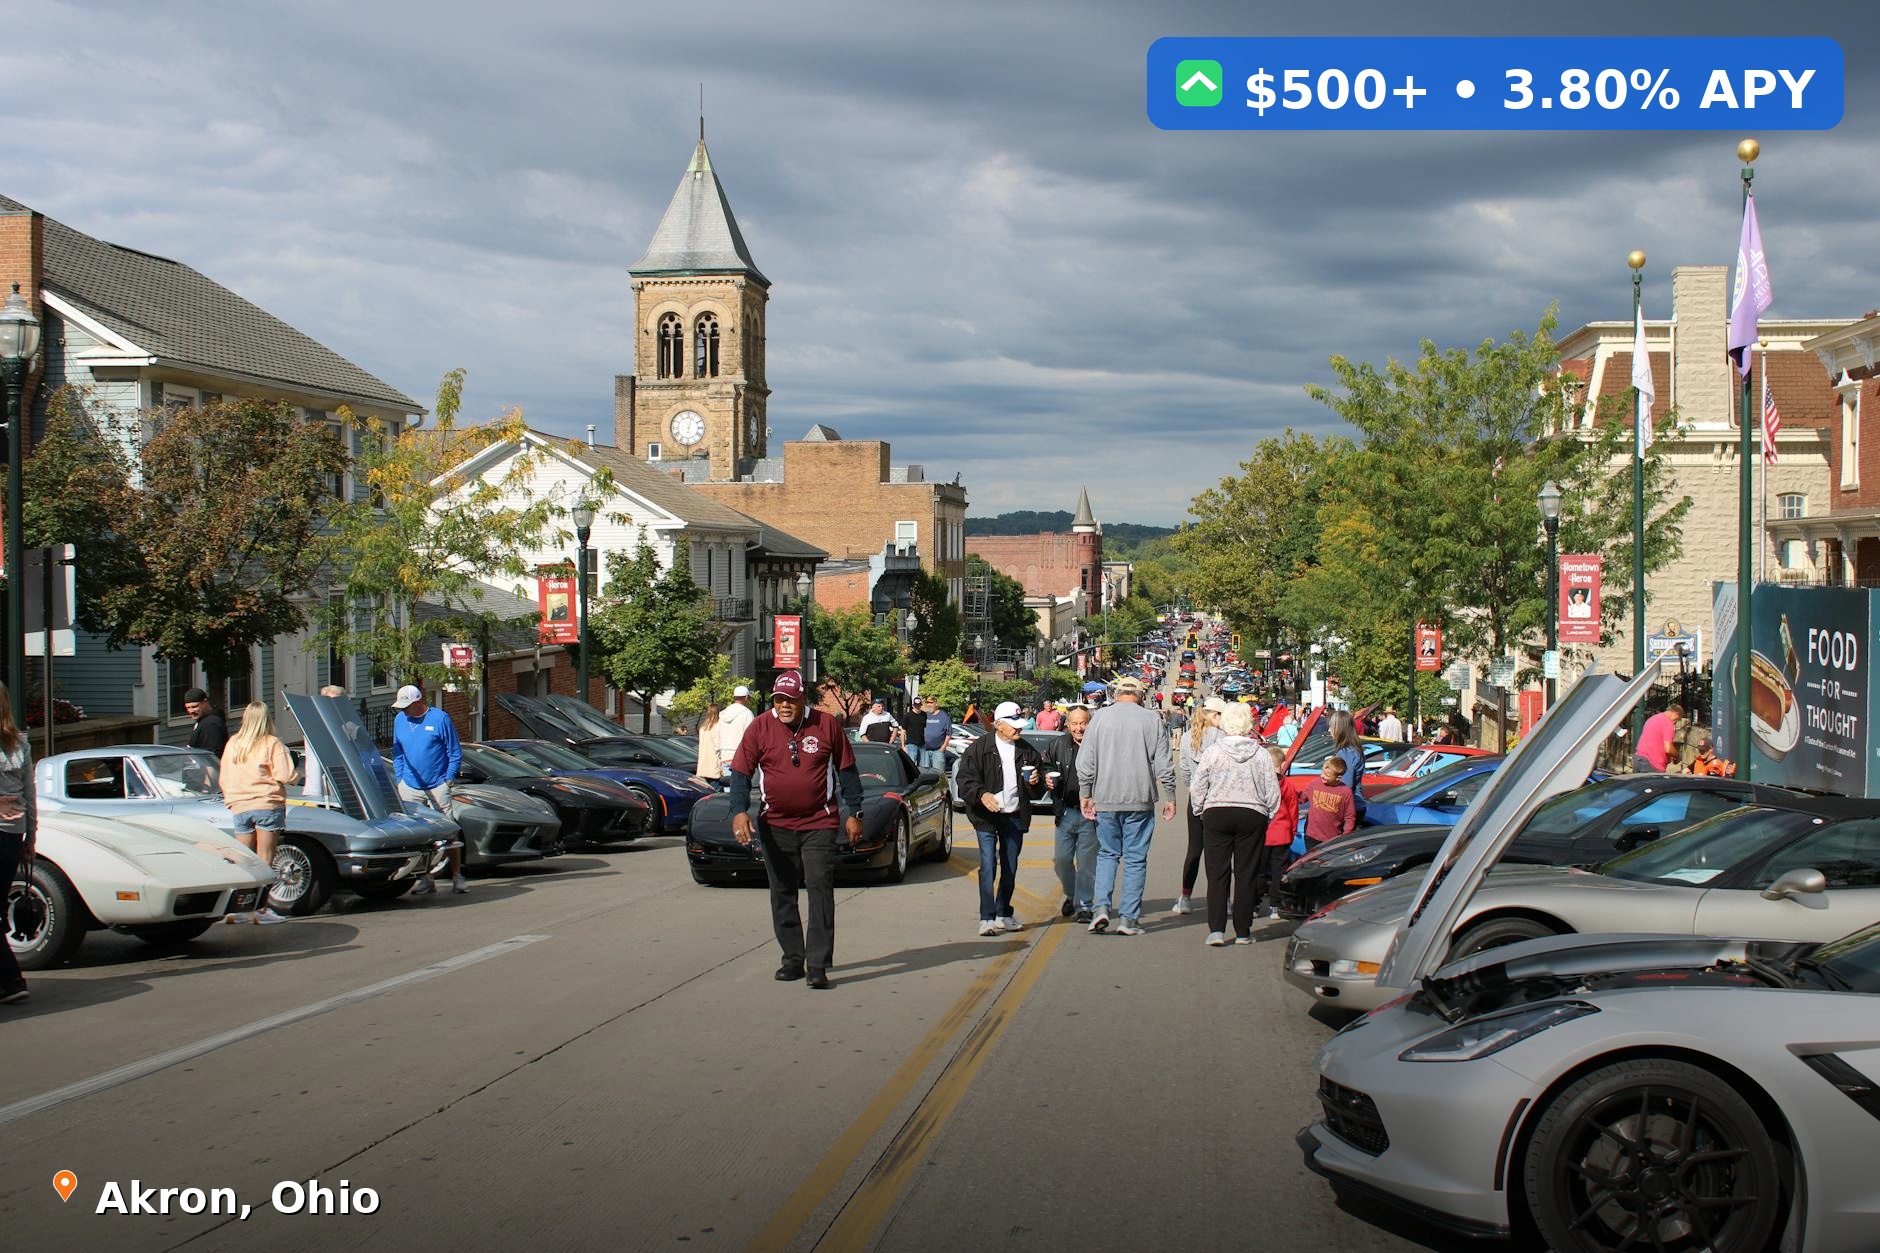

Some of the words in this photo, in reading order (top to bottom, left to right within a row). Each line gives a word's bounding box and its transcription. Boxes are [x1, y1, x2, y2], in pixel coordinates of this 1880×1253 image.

[1560, 562, 1599, 575] Hometown
[1808, 627, 1858, 672] FOOD
[1821, 678, 1840, 700] FOR
[1806, 704, 1858, 740] THOUGHT
[46, 897, 55, 936] Radial
